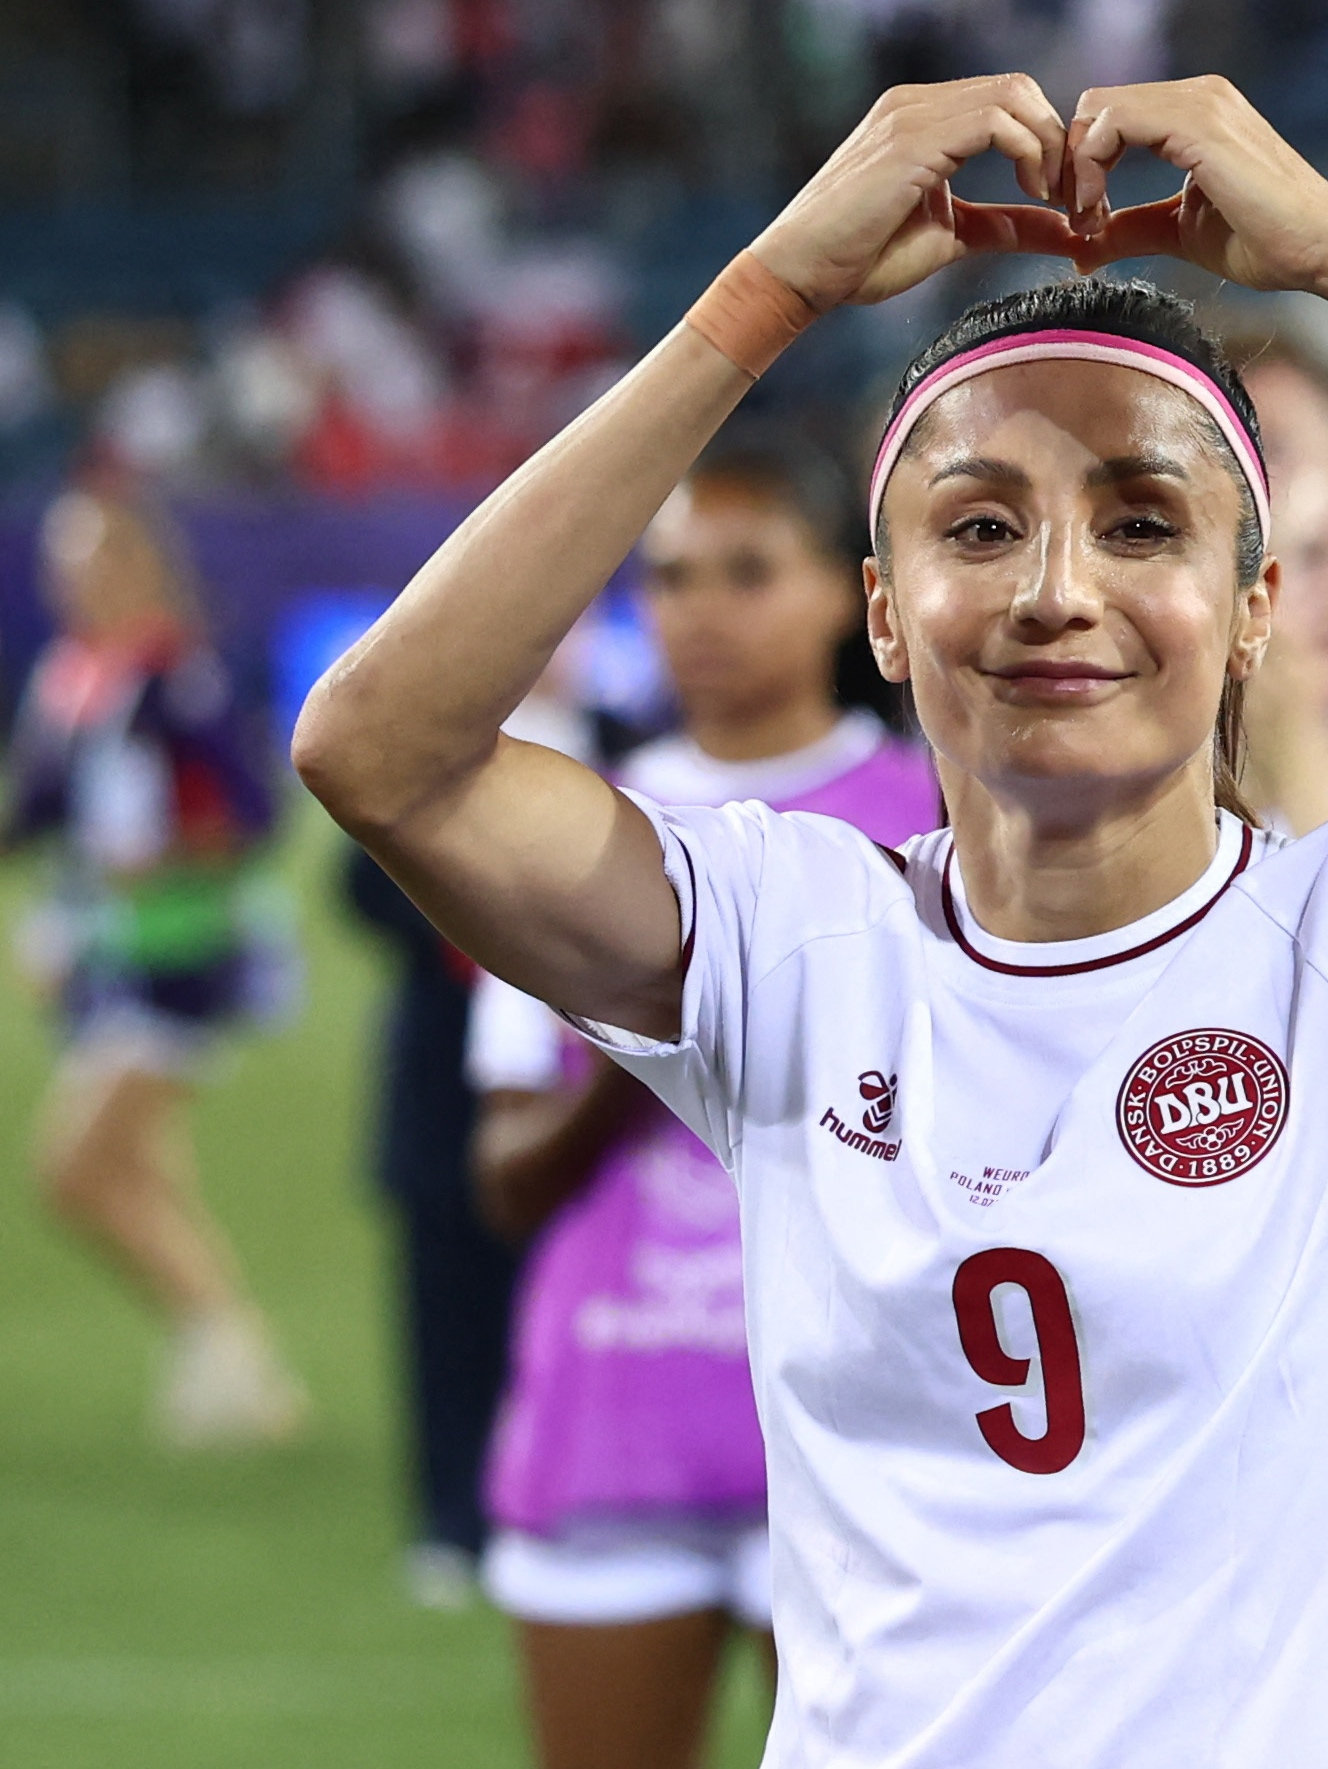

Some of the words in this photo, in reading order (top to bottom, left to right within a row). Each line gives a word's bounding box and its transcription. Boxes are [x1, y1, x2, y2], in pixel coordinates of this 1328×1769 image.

[1127, 1091, 1180, 1173] DANSK
[1187, 1144, 1251, 1177] 1889
[1153, 1071, 1254, 1135] DBU
[949, 1171, 1003, 1196] POLAND
[952, 1246, 1086, 1475] 9
